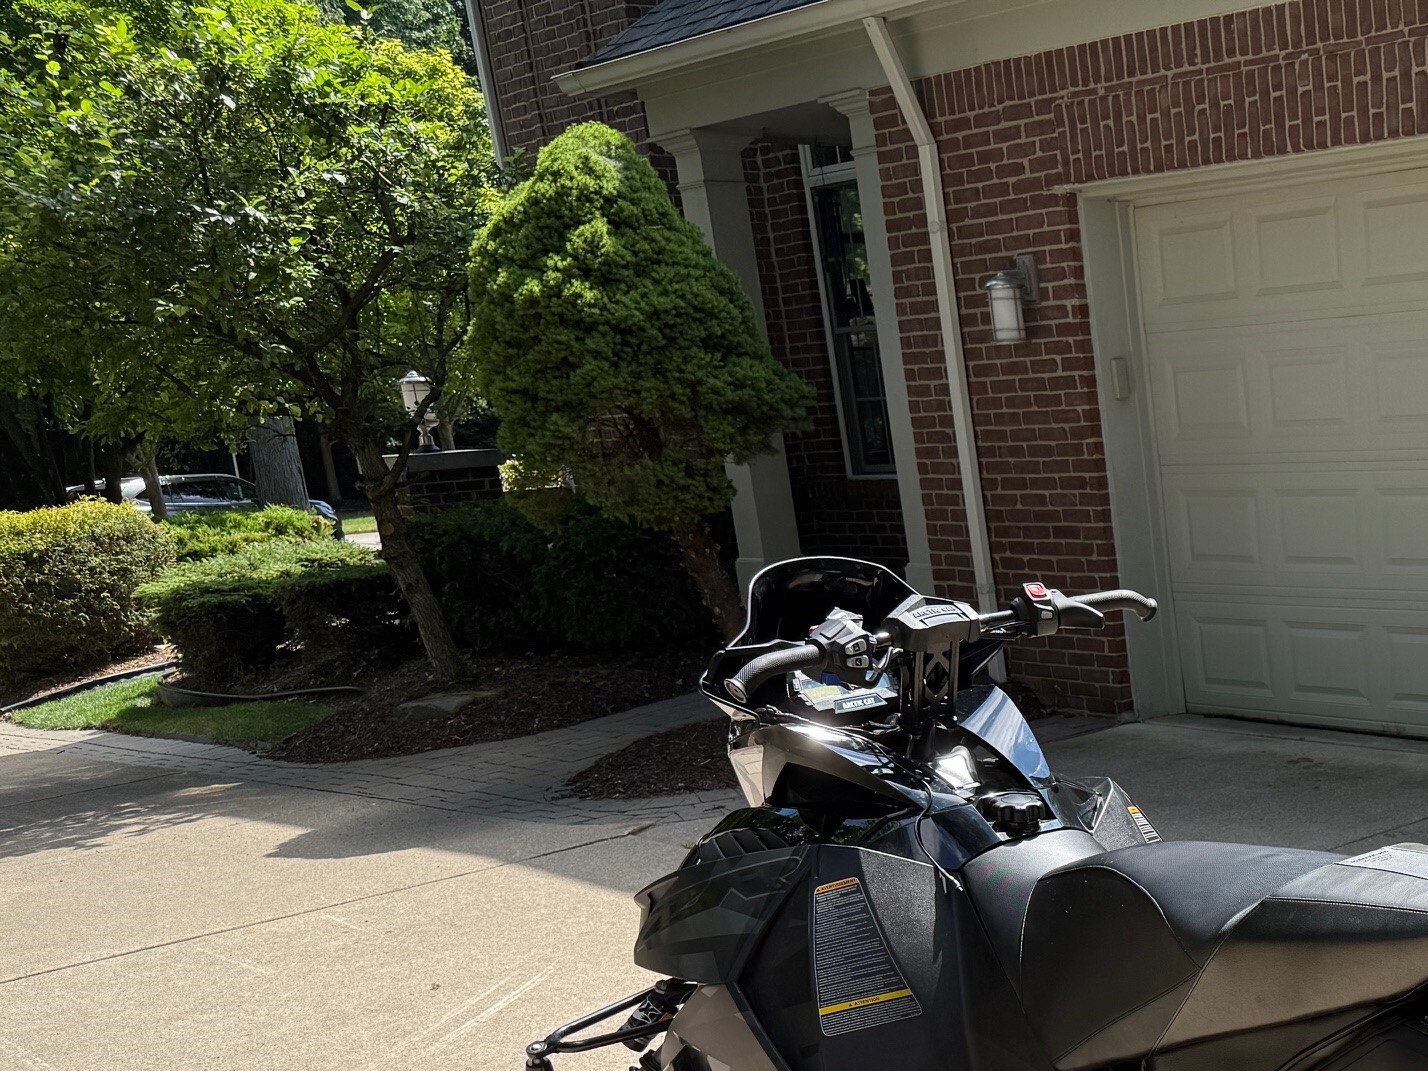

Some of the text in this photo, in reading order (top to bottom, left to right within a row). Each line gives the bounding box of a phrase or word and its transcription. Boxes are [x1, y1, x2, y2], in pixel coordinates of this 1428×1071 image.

[842, 697, 875, 710] ARCTIC CAT
[854, 997, 880, 1006] ATTENTION
